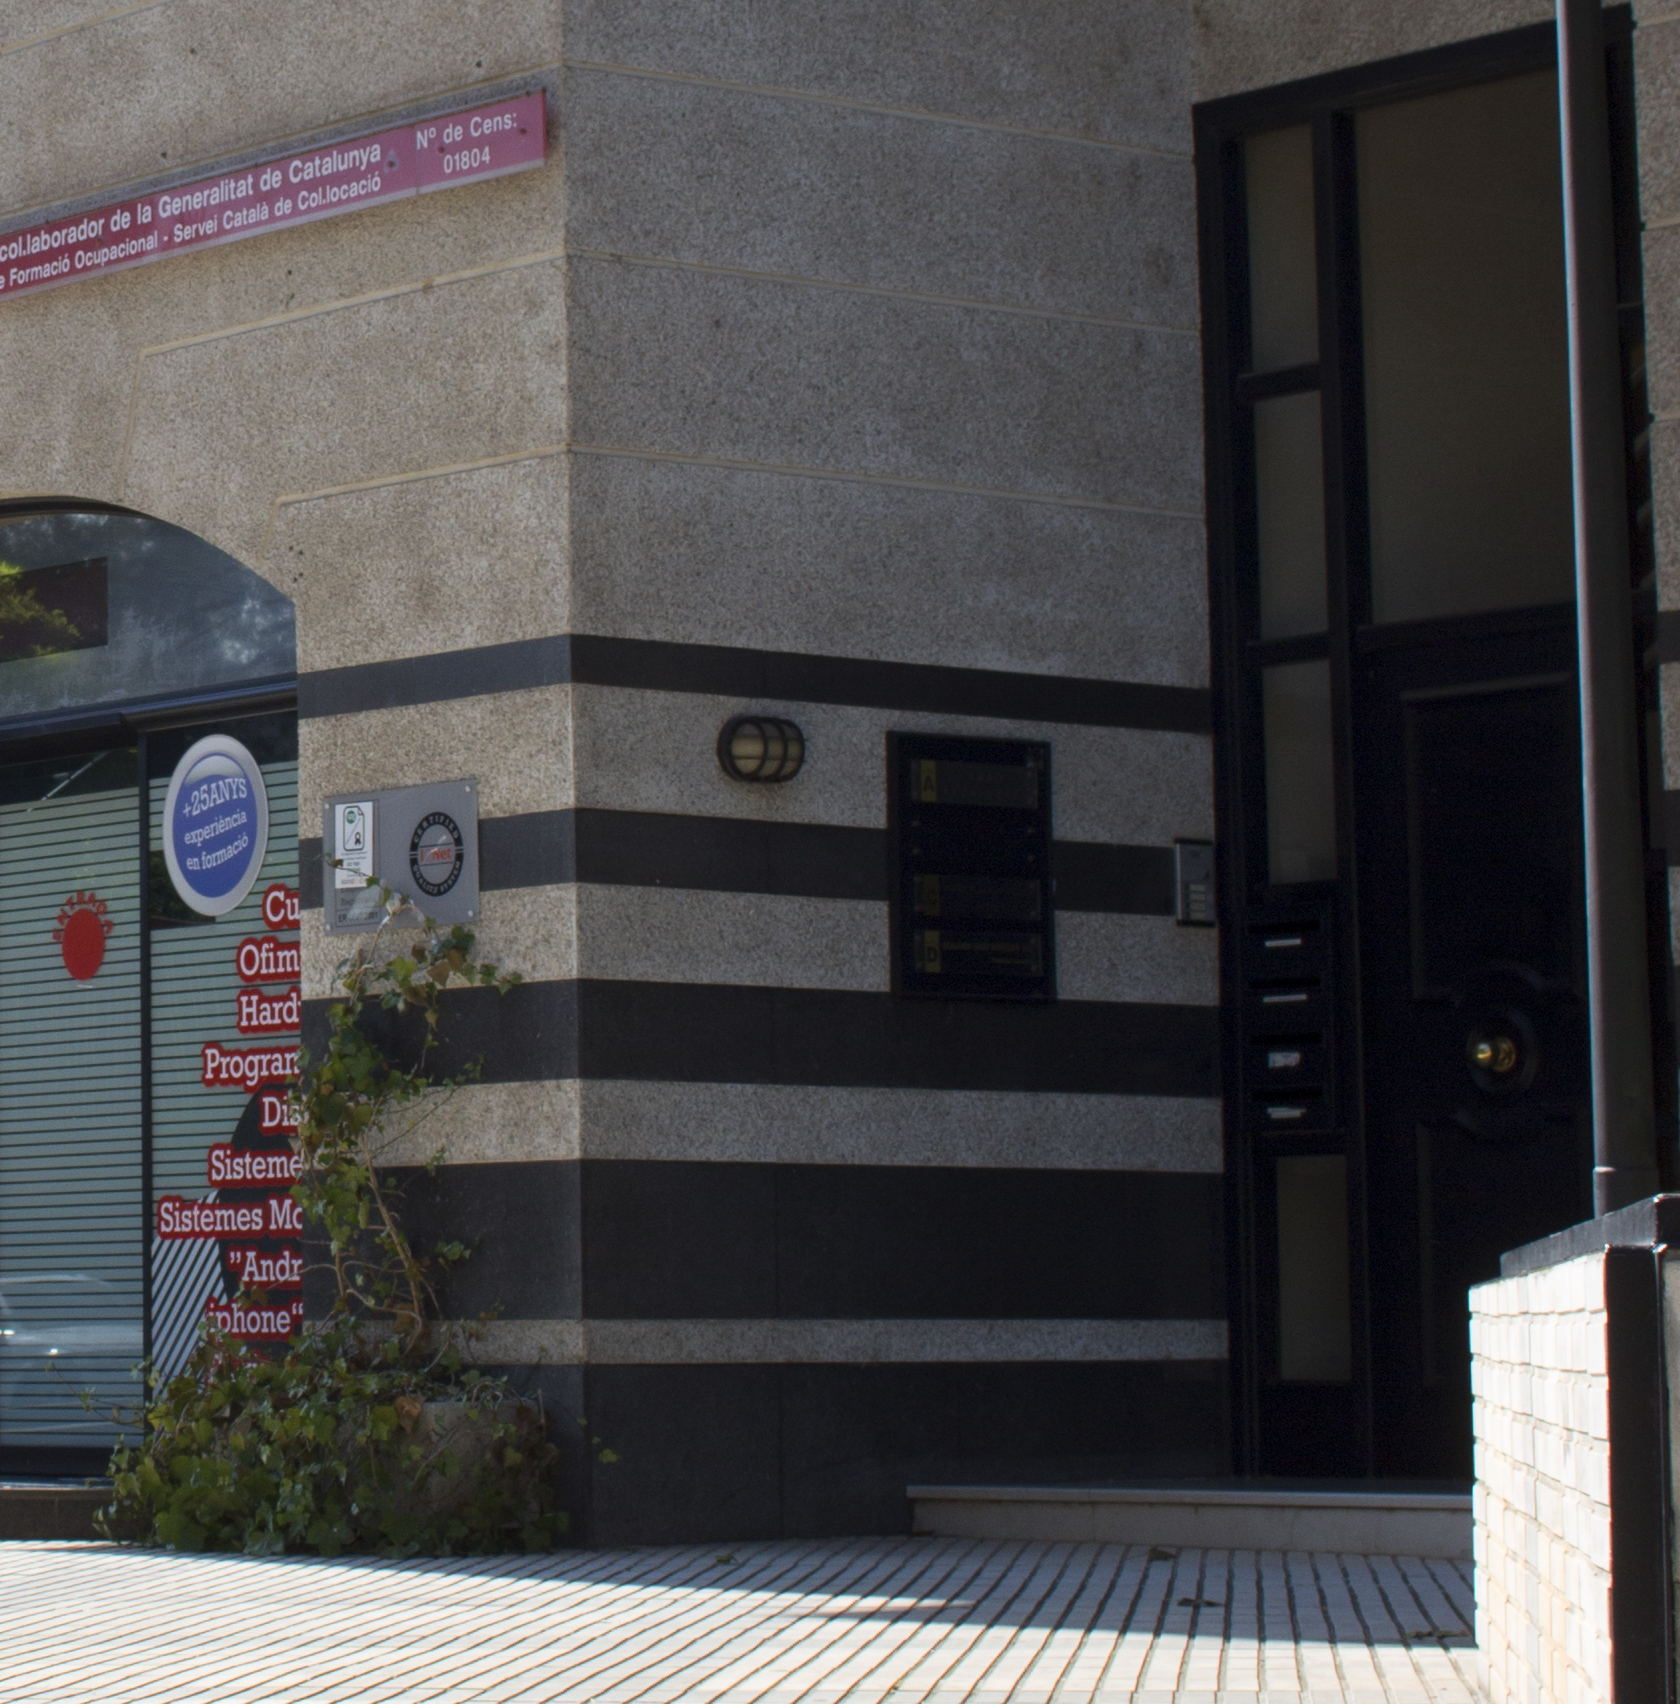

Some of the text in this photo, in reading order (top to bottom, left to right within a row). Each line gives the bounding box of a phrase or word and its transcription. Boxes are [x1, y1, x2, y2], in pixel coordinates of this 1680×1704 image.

[443, 123, 463, 144] de
[470, 112, 517, 137] Cens:
[443, 146, 490, 174] 01804
[110, 209, 131, 232] de
[137, 203, 152, 224] la
[158, 174, 253, 218] Generalitat
[260, 168, 282, 191] de
[289, 143, 381, 183] Catalunya
[10, 253, 70, 287] Formació
[75, 231, 157, 269] Ocupacional
[173, 215, 217, 243] Servei
[223, 202, 269, 230] Català
[274, 197, 292, 216] de
[183, 778, 247, 818] +25ANYS
[184, 809, 247, 846] experiència
[186, 832, 249, 871] en formació
[266, 891, 300, 922] Cu
[240, 943, 300, 976] Ofim
[240, 992, 301, 1026] Hard
[262, 1096, 301, 1127] Dis
[211, 1149, 303, 1181] Sisteme
[160, 1202, 263, 1233] Sistemes
